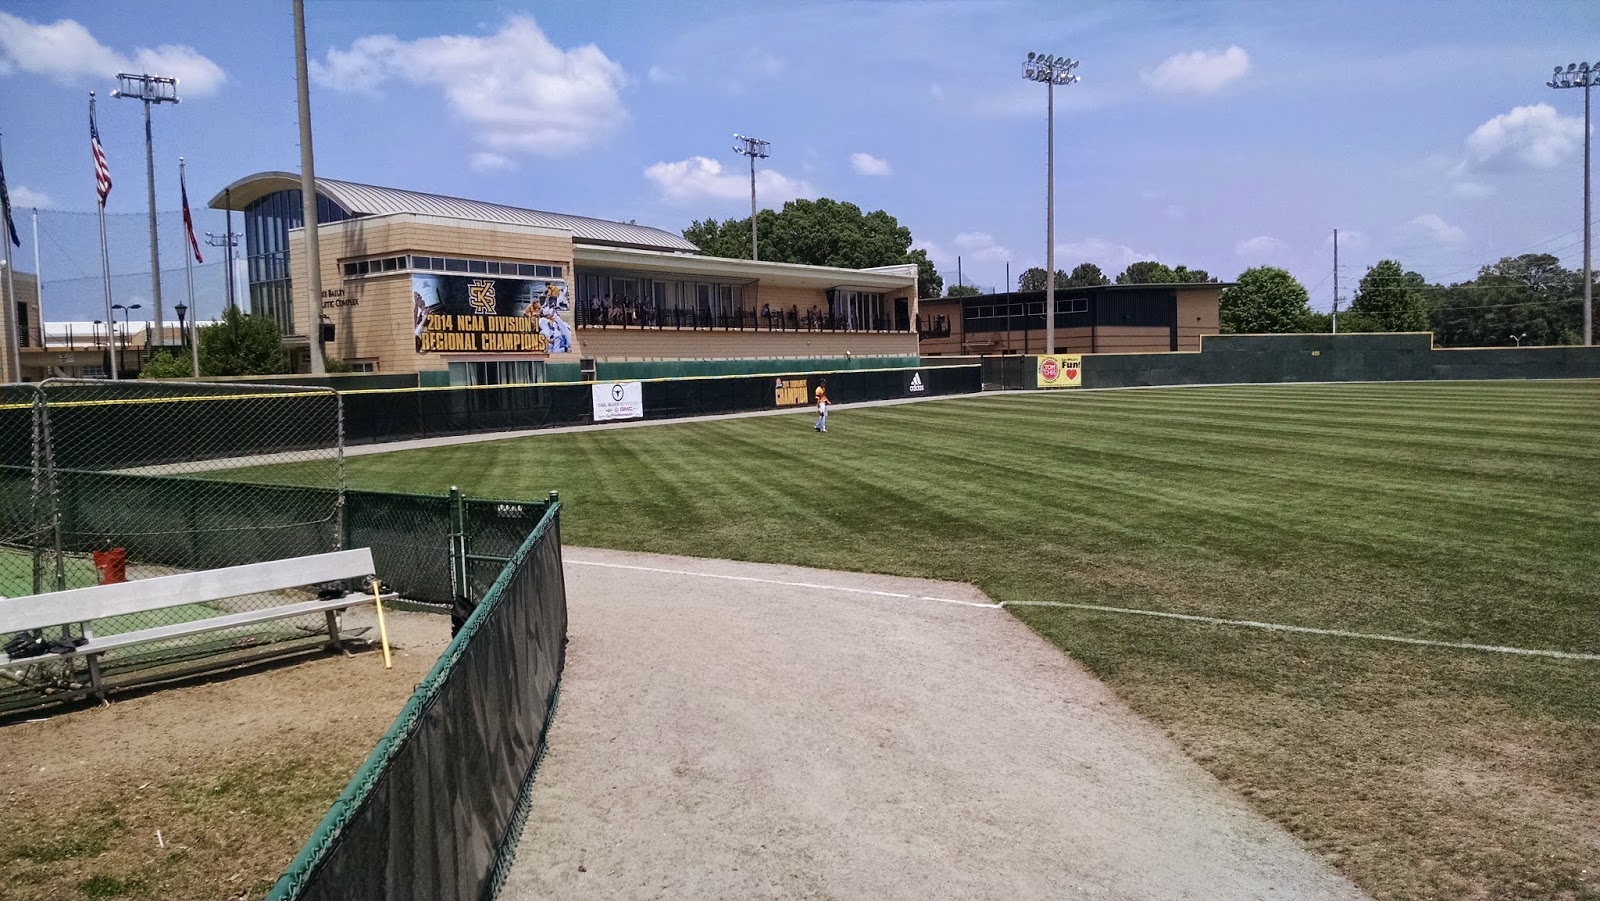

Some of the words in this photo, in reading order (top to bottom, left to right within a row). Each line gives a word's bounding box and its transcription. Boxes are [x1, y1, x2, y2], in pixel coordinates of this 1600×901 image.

[336, 298, 359, 307] COMPLEX
[427, 314, 453, 331] 2014
[457, 315, 485, 332] NCAA
[488, 315, 532, 332] DIVISION
[421, 332, 477, 351] REGIONAL
[481, 333, 546, 351] CHAMPIONS
[1062, 361, 1081, 369] Fun!
